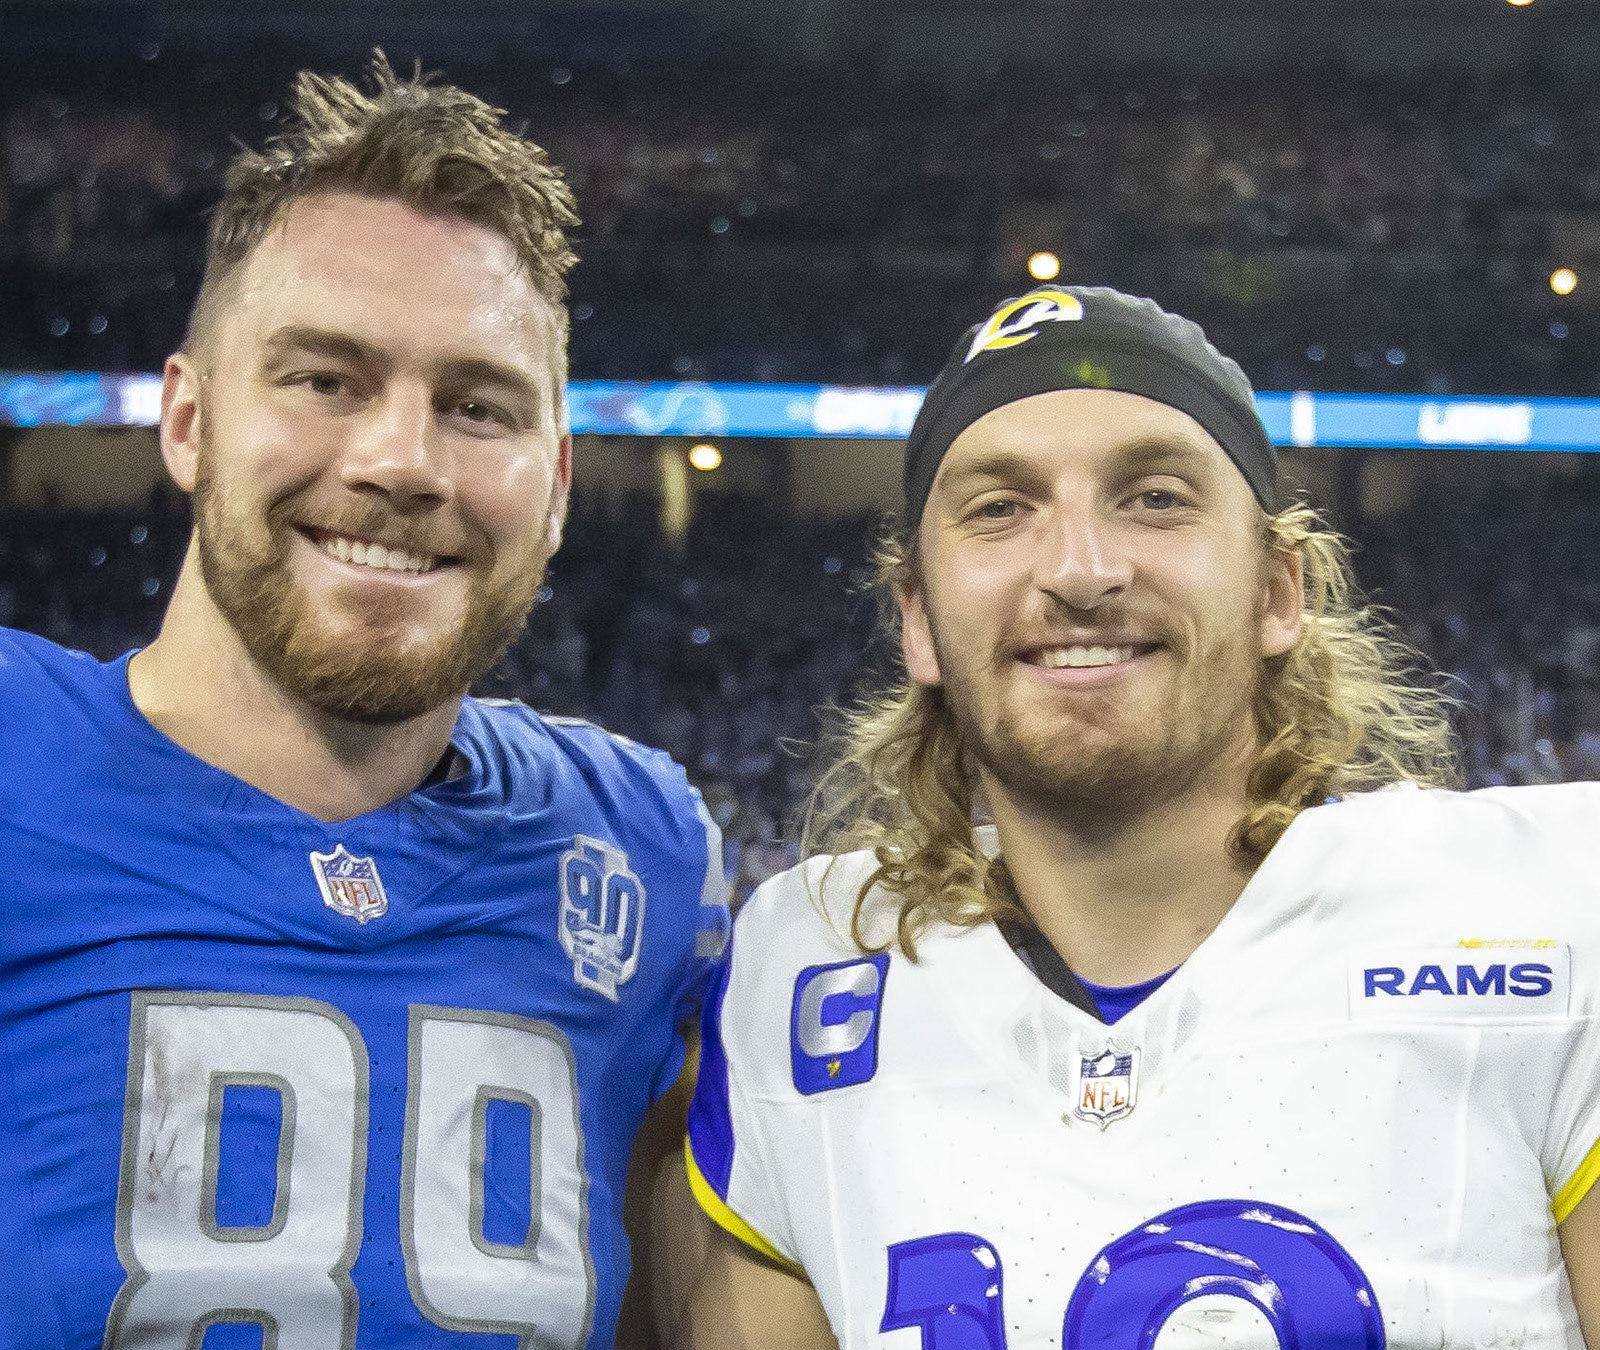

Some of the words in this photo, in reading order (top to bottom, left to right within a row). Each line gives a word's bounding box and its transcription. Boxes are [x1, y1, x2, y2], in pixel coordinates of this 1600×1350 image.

[329, 879, 380, 907] NFL
[1363, 963, 1553, 998] RAMS
[798, 961, 880, 1058] C
[1082, 1081, 1125, 1112] NFL
